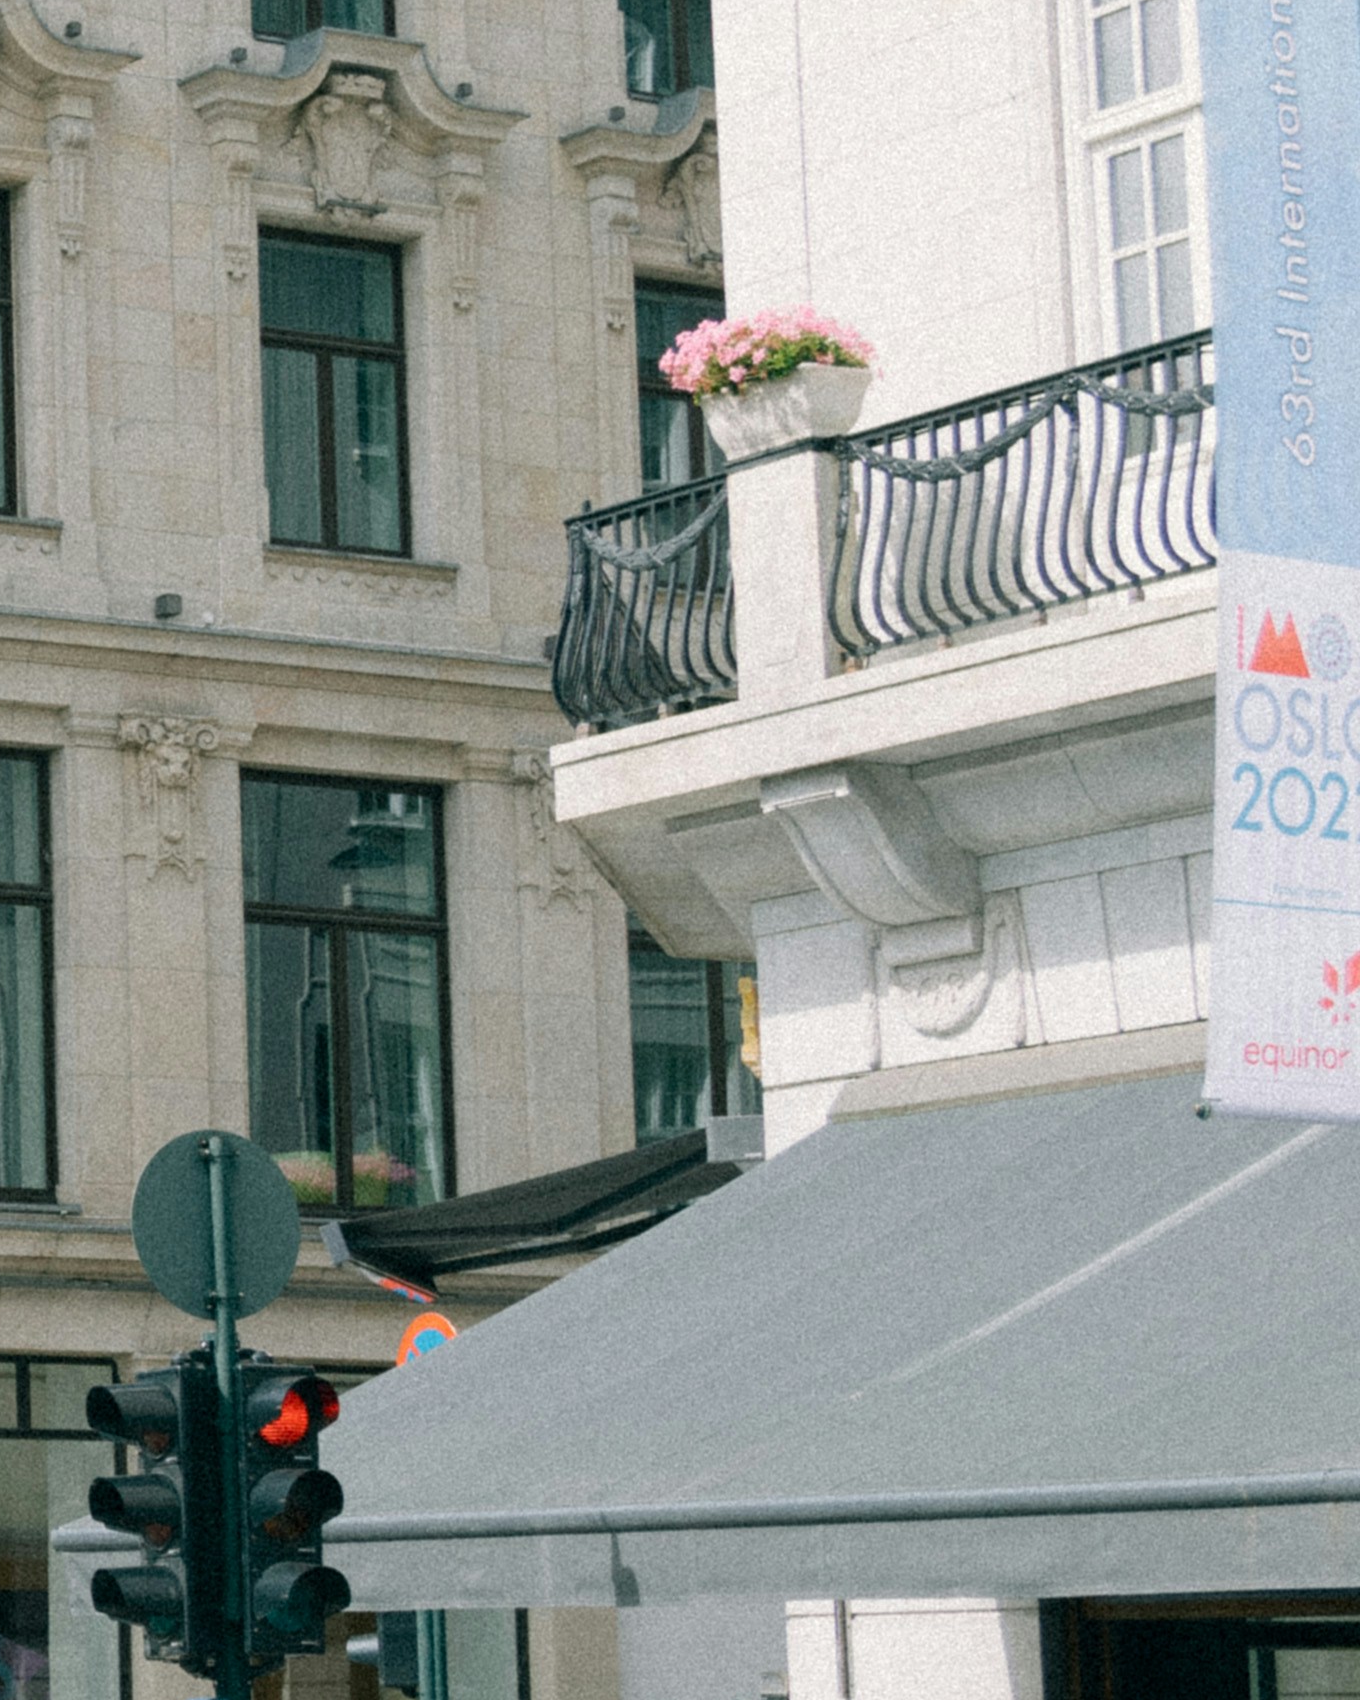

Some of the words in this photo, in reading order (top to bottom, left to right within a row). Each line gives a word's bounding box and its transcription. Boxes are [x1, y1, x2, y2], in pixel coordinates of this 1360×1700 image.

[1275, 326, 1318, 468] 63rd
[1231, 761, 1360, 846] 202
[1242, 1037, 1351, 1076] equinor
